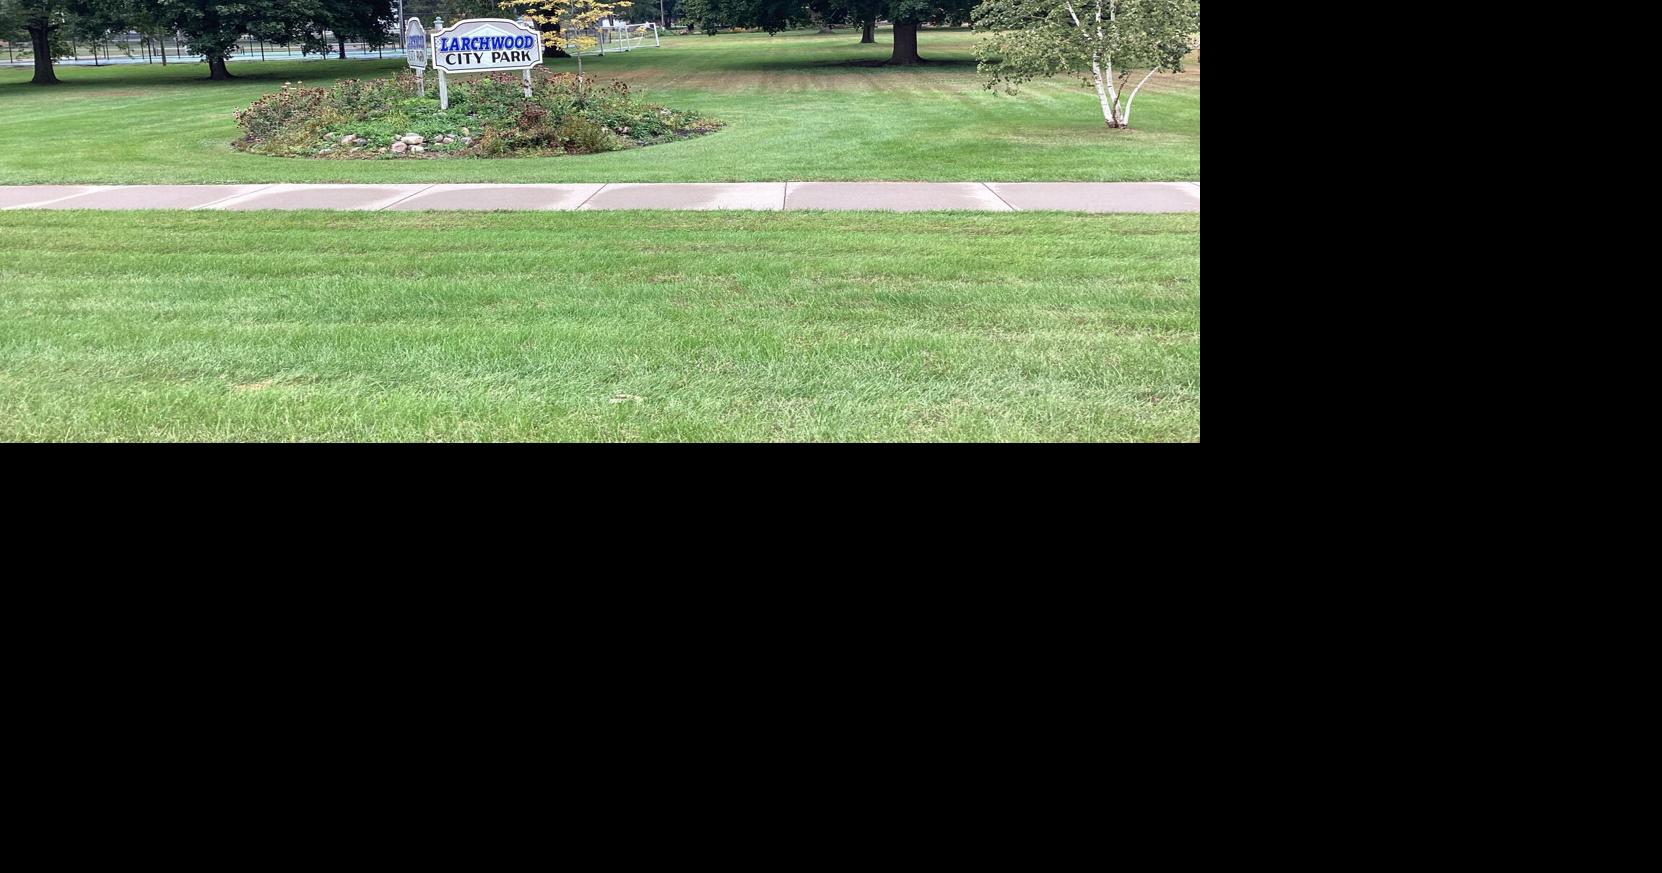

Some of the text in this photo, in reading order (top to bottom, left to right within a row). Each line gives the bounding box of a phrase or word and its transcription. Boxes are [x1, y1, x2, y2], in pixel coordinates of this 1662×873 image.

[440, 35, 534, 53] LARCHWOOD
[445, 50, 531, 65] CITY PARK
